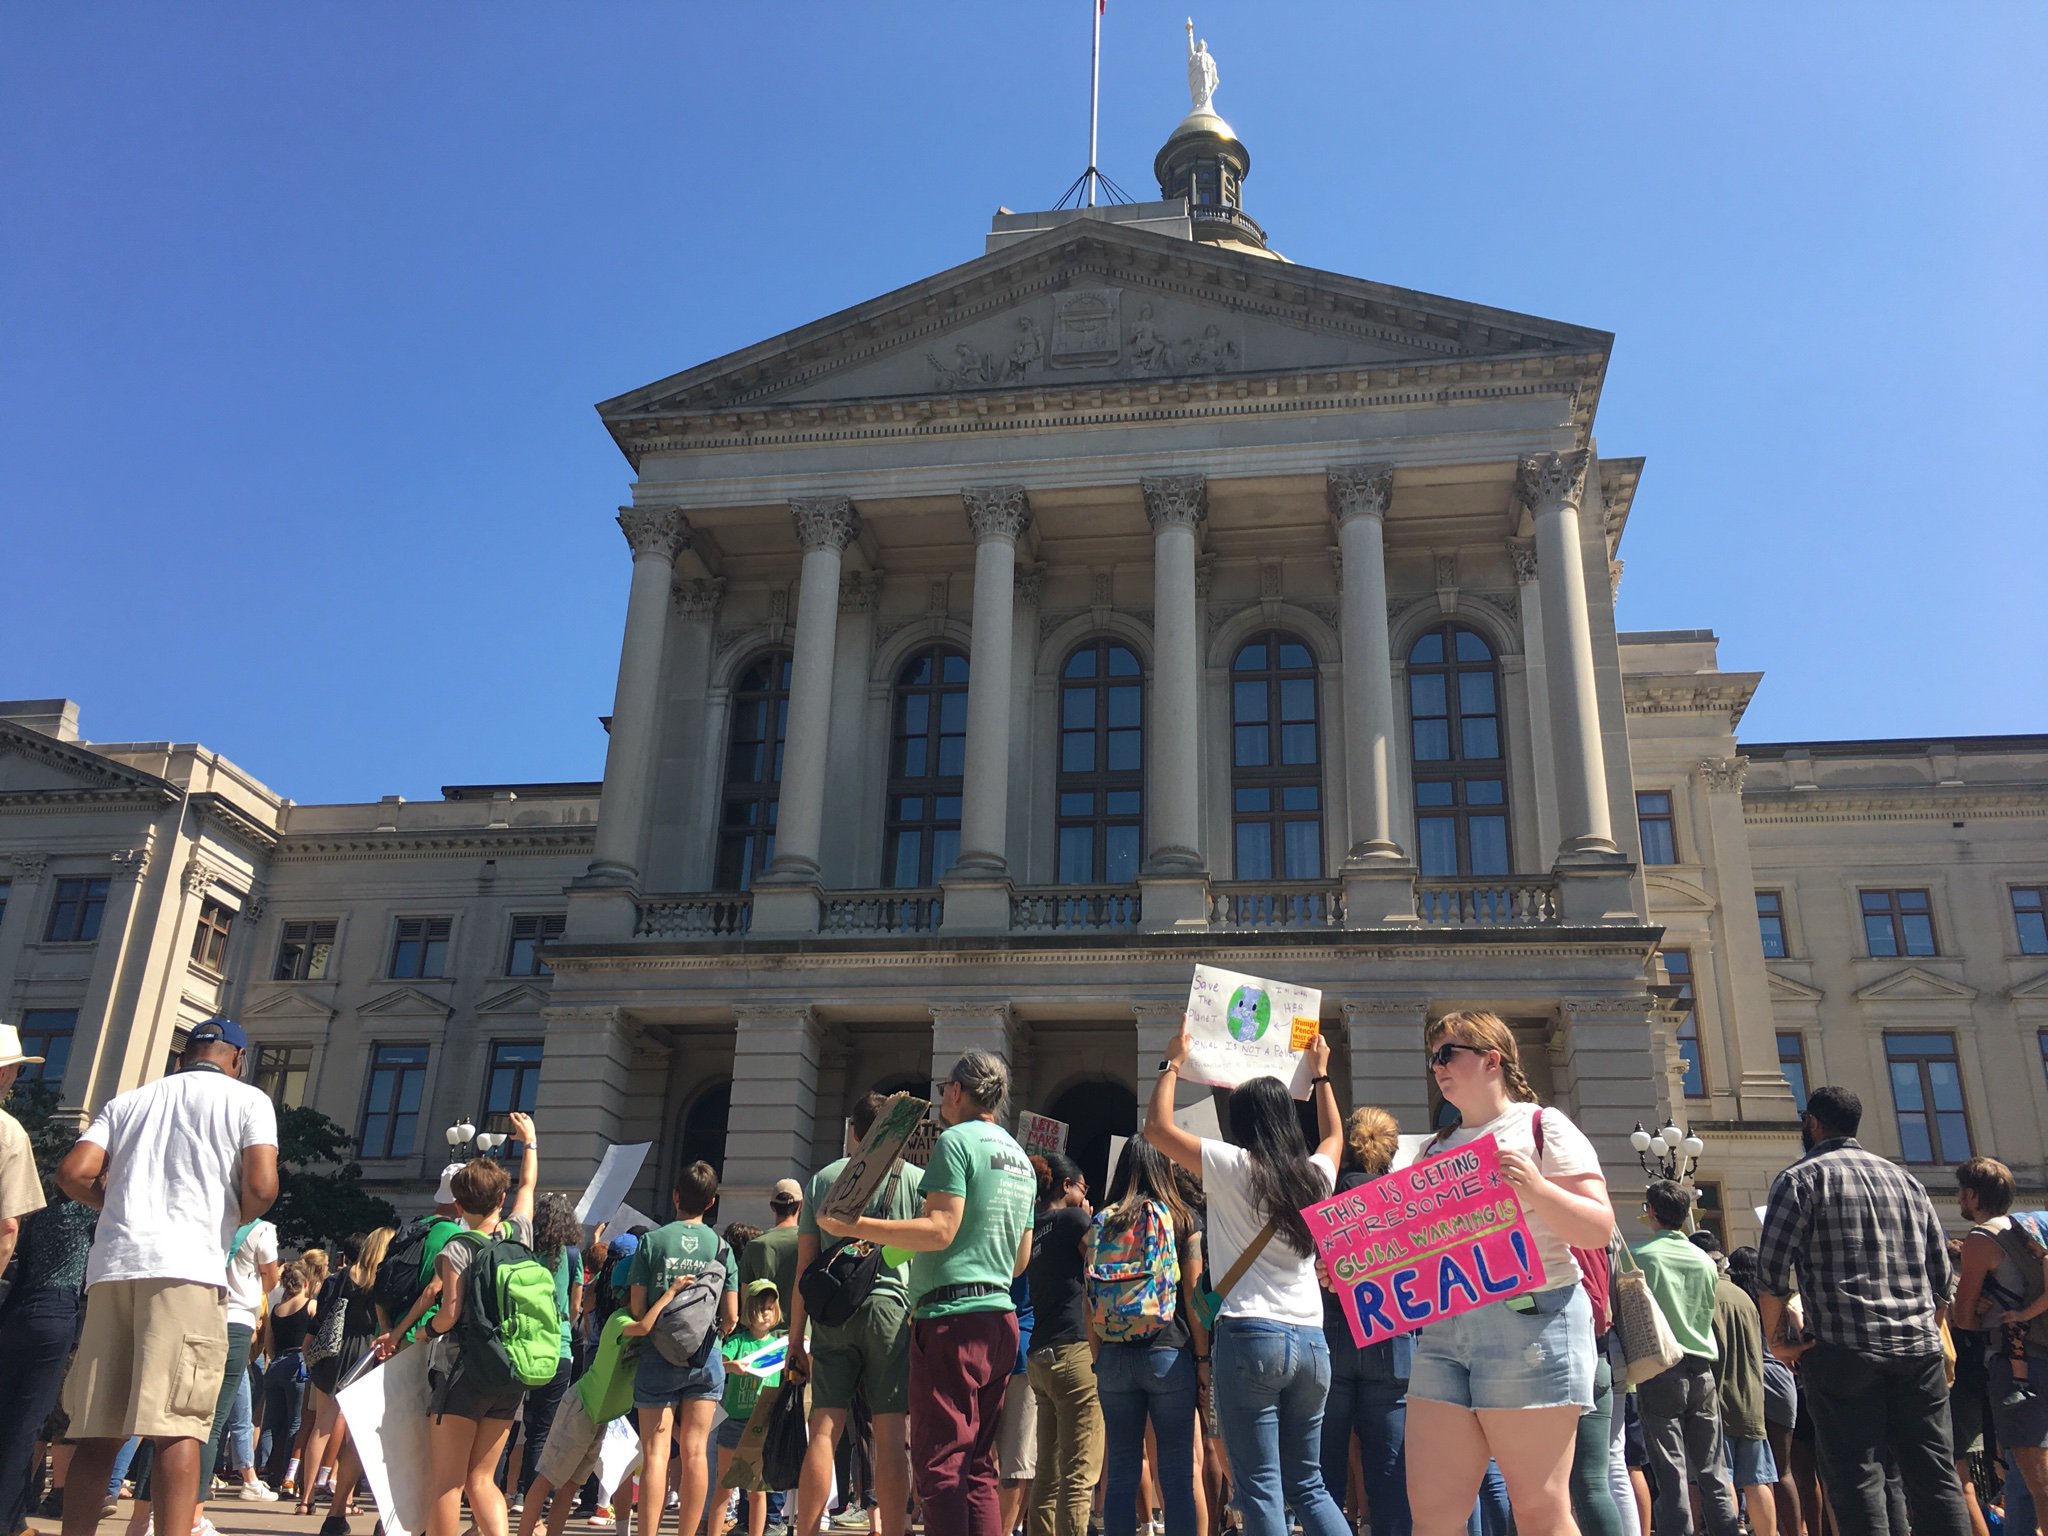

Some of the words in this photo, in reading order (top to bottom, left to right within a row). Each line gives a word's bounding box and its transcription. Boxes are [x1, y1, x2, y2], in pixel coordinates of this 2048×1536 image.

[1193, 975, 1218, 992] Save
[1242, 1044, 1261, 1054] NOT
[908, 1137, 938, 1150] WAIT
[1027, 1131, 1059, 1150] MAKE
[1318, 1194, 1366, 1225] THIS
[1377, 1180, 1402, 1204] IS
[1410, 1150, 1480, 1191] GETTING
[1335, 1238, 1409, 1280] GLOBAL
[1408, 1204, 1496, 1248] WARMING
[1496, 1199, 1517, 1220] IS
[1352, 1229, 1535, 1339] REAL!
